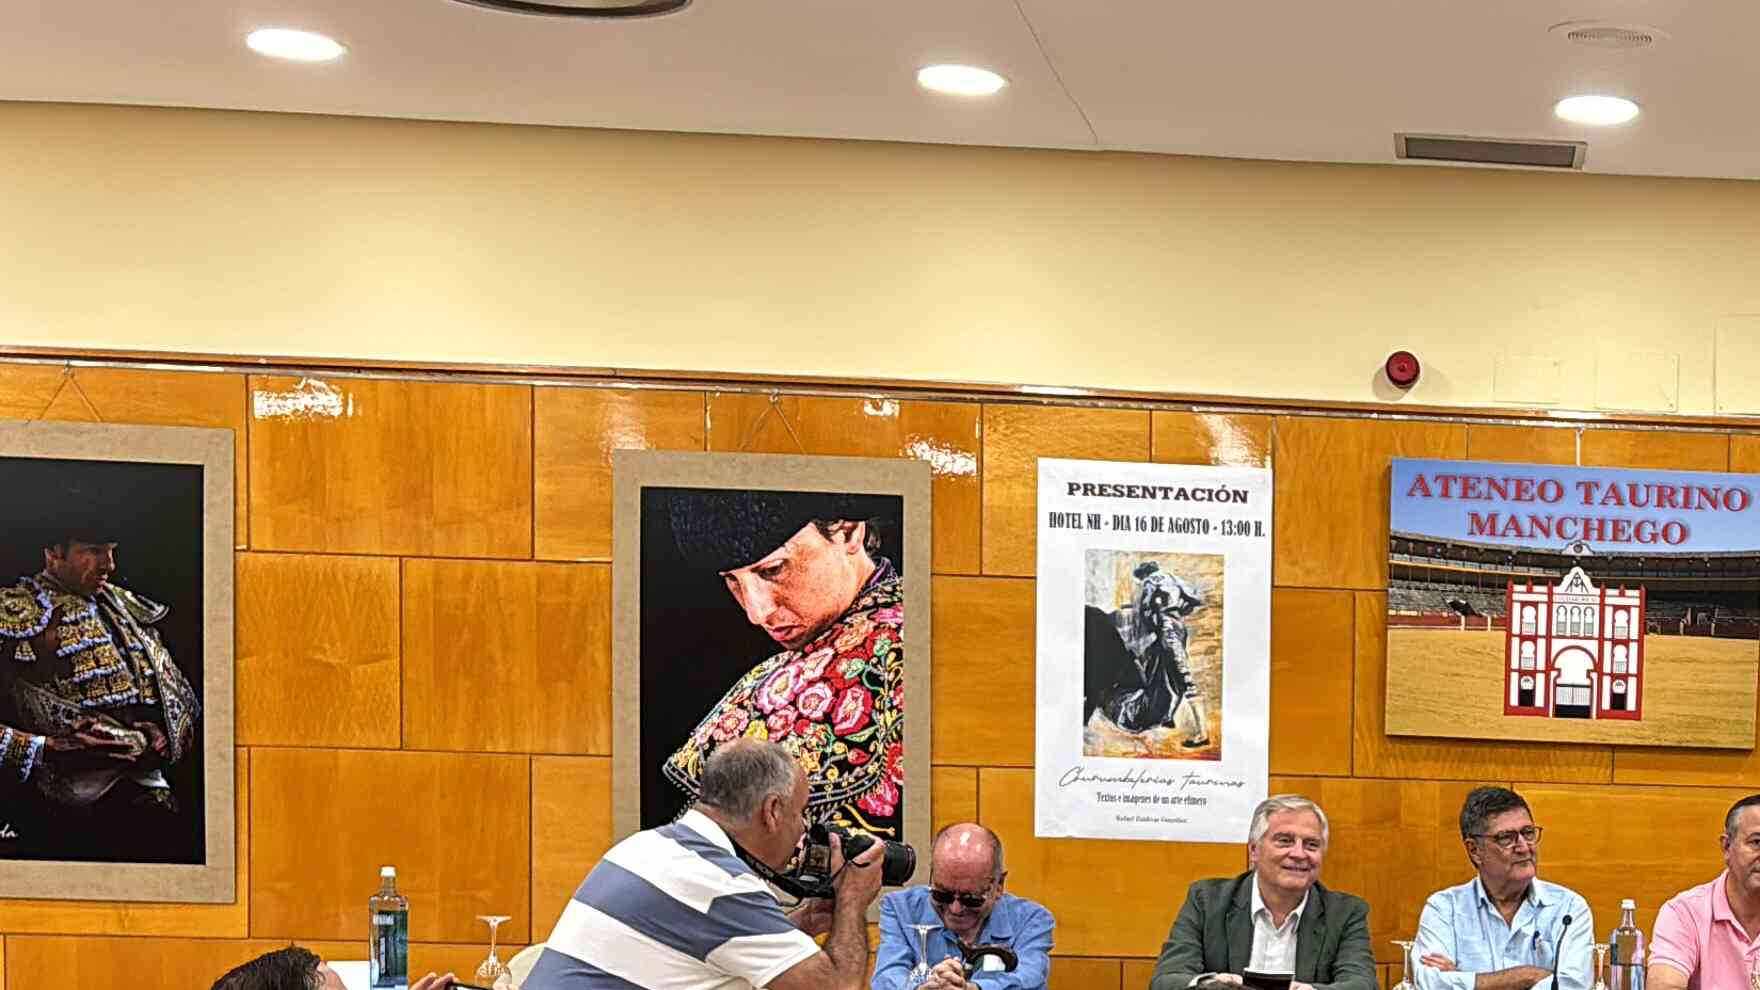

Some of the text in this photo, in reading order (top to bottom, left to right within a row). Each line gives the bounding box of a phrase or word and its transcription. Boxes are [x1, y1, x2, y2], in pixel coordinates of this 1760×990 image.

[1067, 482, 1249, 504] PRESENTACIÓN
[1407, 473, 1752, 513] ATENEO TAURINO
[1048, 511, 1083, 529] HOTEL
[1087, 513, 1101, 530] NH
[1135, 515, 1147, 532] 16
[1151, 516, 1164, 533] DE
[1168, 517, 1210, 535] AGOSTO
[1221, 519, 1251, 537] 13:00
[1254, 520, 1265, 538] H.
[1466, 511, 1689, 545] MANCHEGO
[1097, 791, 1116, 802] Textos
[1153, 793, 1160, 804] de
[1161, 795, 1169, 804] un
[1171, 796, 1183, 805] arte
